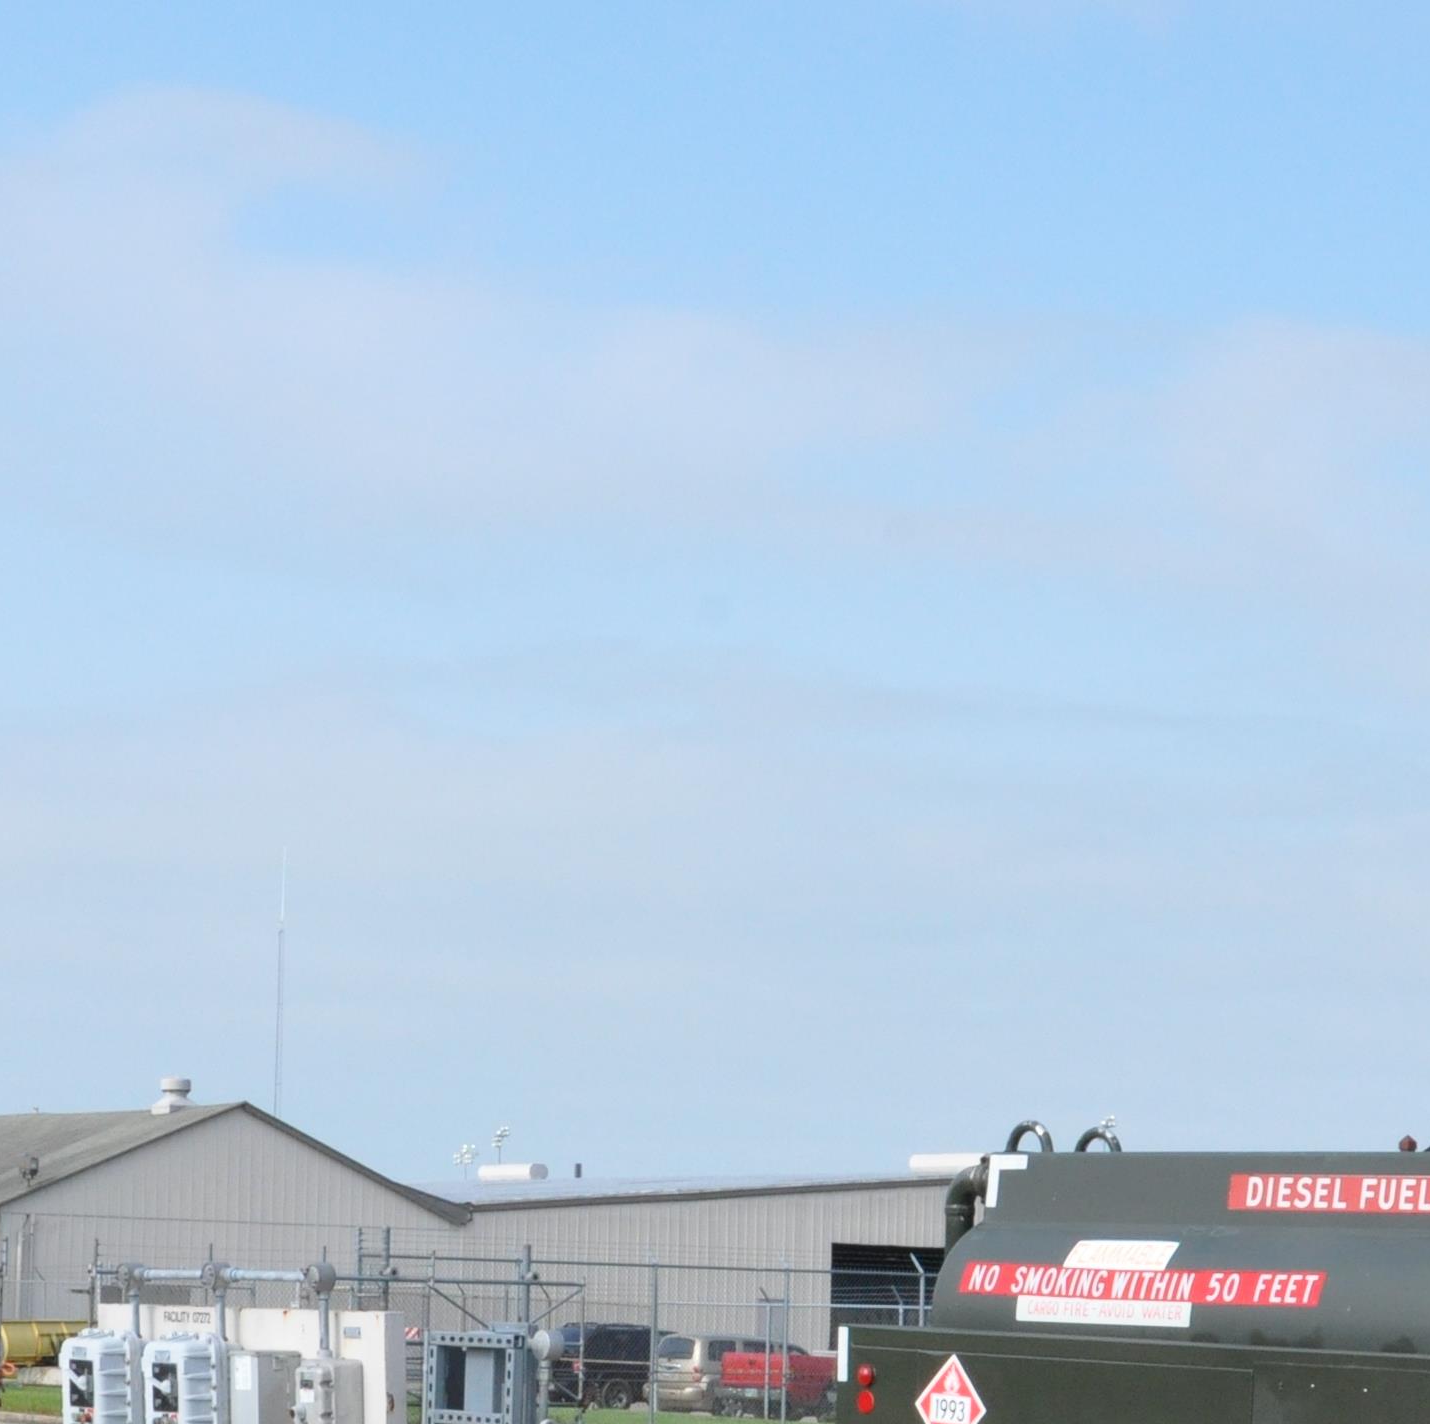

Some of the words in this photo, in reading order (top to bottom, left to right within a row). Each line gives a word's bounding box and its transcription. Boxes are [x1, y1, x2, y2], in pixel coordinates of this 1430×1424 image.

[1245, 1175, 1348, 1209] DIESEL
[967, 1264, 1001, 1292] NO
[1010, 1266, 1108, 1299] SMOKING
[1111, 1270, 1195, 1301] WITHIN
[1205, 1272, 1241, 1302] 50
[1252, 1273, 1320, 1305] FEET
[1027, 1299, 1059, 1316] CARGO
[1141, 1303, 1183, 1321] WATER
[935, 1398, 965, 1422] 1993
